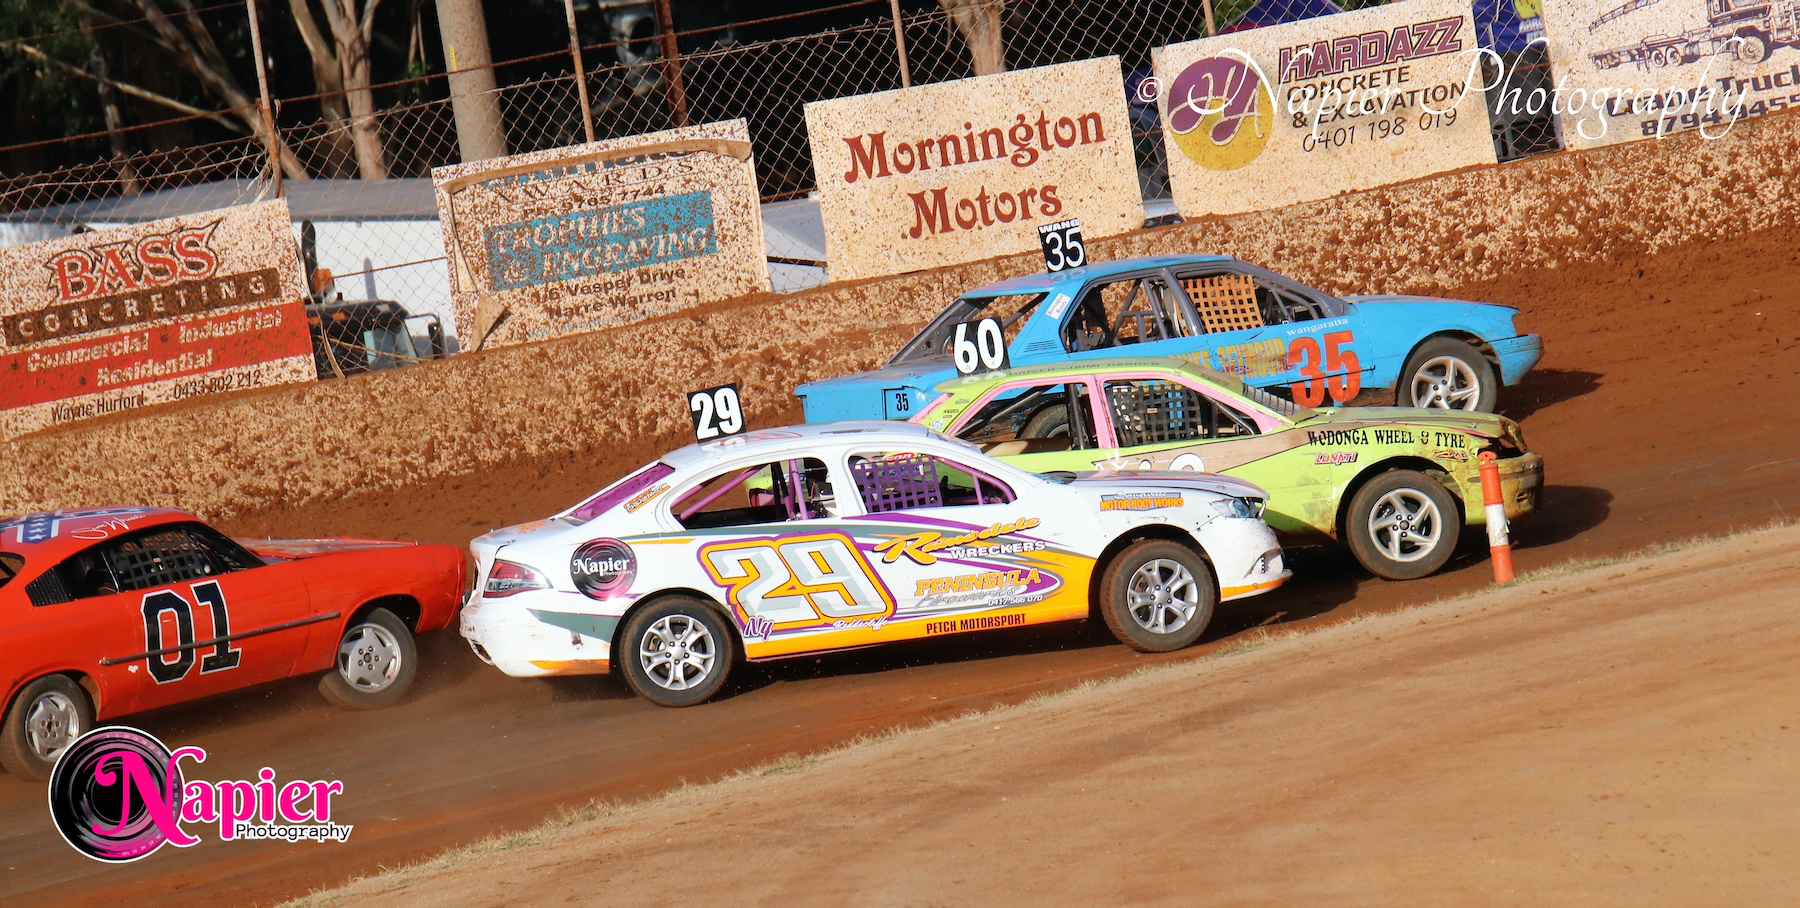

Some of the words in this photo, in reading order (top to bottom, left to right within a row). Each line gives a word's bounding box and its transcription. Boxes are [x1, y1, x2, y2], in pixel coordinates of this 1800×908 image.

[1279, 16, 1463, 85] HARDAZZ
[1287, 66, 1411, 103] CONCRETE
[1292, 111, 1309, 128] &
[1317, 82, 1466, 125] EXCAVATION
[1303, 126, 1355, 152] 0401
[1368, 117, 1406, 141] 198
[1419, 108, 1457, 130] 019
[1640, 110, 1722, 137] 8794
[842, 109, 1106, 183] Mornington
[907, 184, 1062, 239] Motors
[1038, 219, 1080, 234] WANG
[51, 226, 220, 301] BASS
[543, 228, 708, 274] ENGRAVING
[1046, 226, 1084, 272] 35
[566, 274, 635, 298] Vesper
[640, 266, 685, 286] Drive
[611, 288, 676, 309] Warren
[19, 275, 267, 337] CONCRETING
[27, 332, 149, 372] Commercial
[179, 308, 283, 344] Industrial
[954, 318, 1004, 375] 60
[1286, 318, 1349, 336] wangaratta
[97, 349, 213, 387] Residential
[1288, 330, 1361, 409] 35
[690, 387, 743, 440] 29
[895, 393, 909, 412] 35
[1307, 429, 1369, 446] WODONGA
[1375, 430, 1415, 445] WHEEL
[1435, 432, 1466, 449] TYRE
[1100, 499, 1130, 511] MOTOR
[1131, 498, 1153, 510] BODY
[1154, 497, 1184, 508] WORKS
[573, 556, 630, 577] Napier
[950, 540, 1046, 560] WRECKERS
[700, 533, 893, 629] 29
[914, 567, 1041, 597] PENINSULA
[1027, 594, 1043, 603] 070
[141, 579, 242, 685] 01
[926, 619, 957, 635] PETCH
[961, 613, 1026, 631] MOTORSPORT
